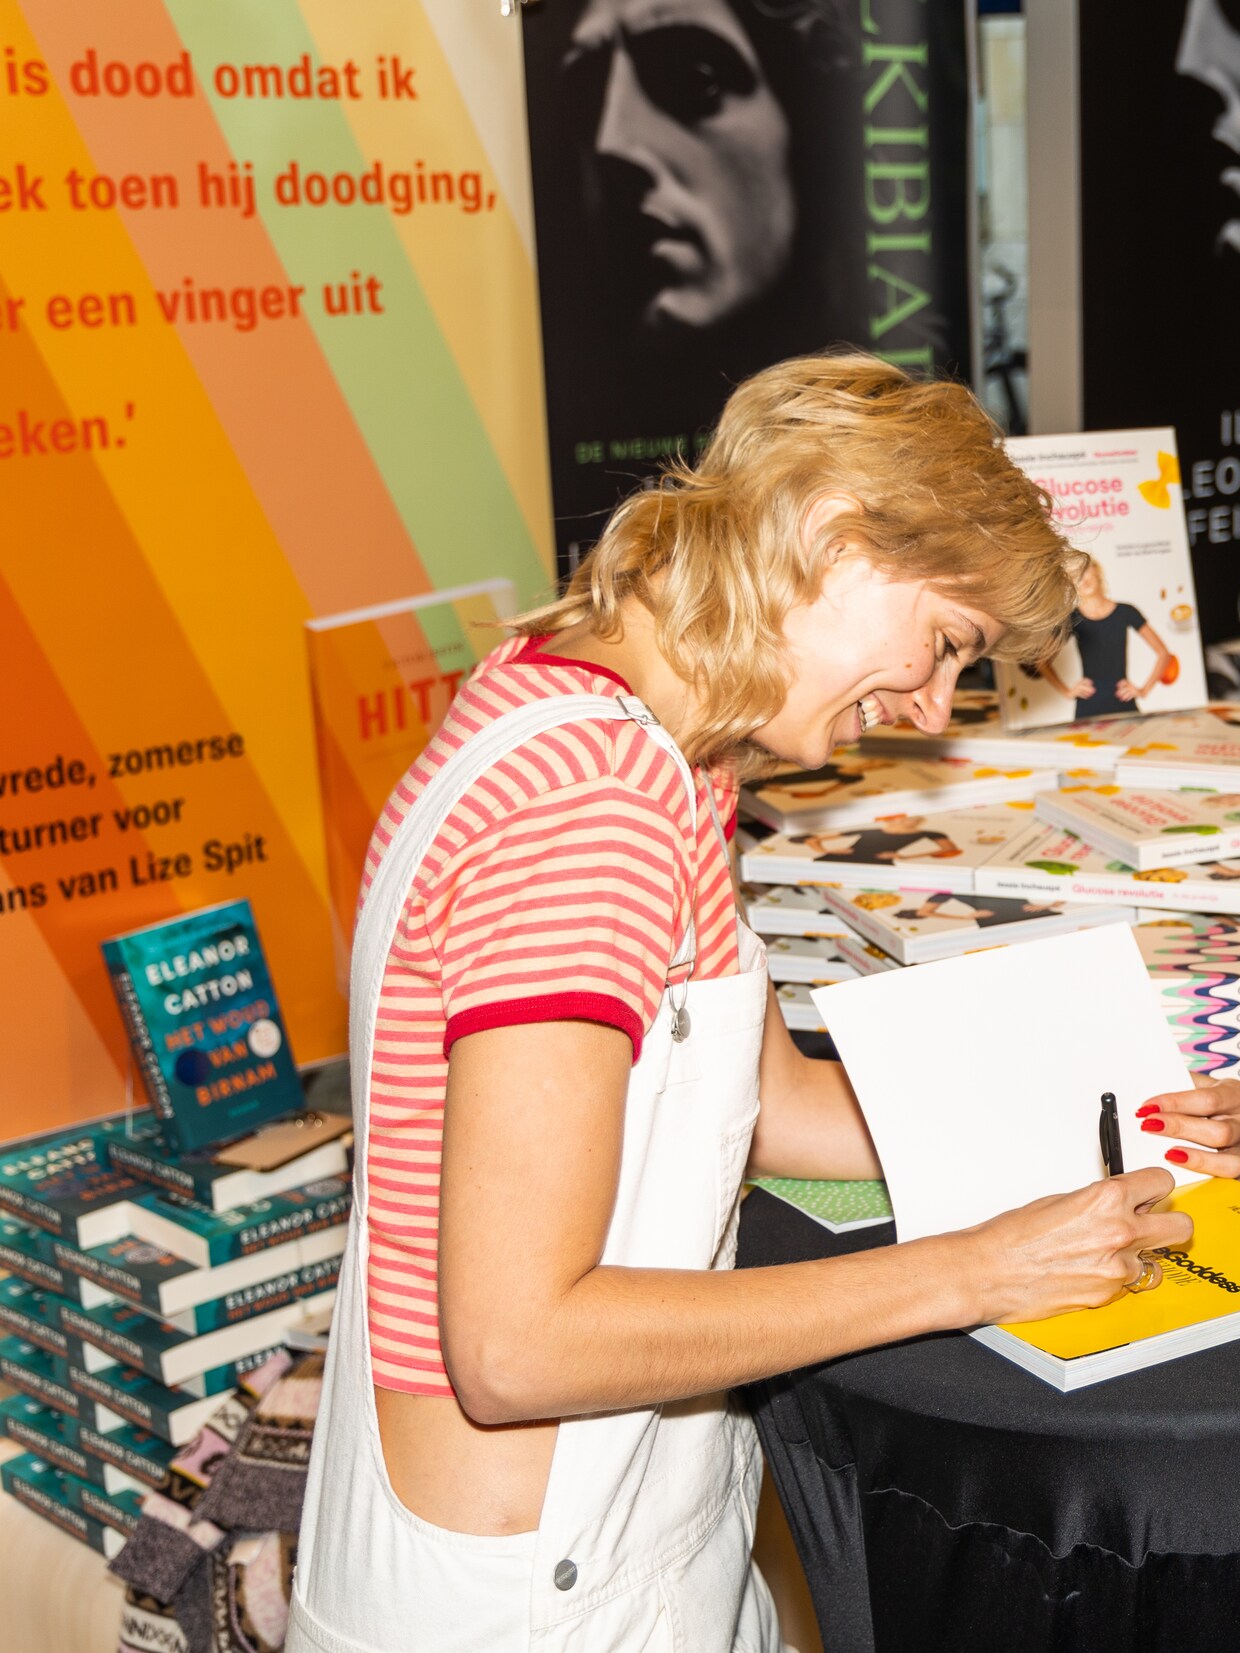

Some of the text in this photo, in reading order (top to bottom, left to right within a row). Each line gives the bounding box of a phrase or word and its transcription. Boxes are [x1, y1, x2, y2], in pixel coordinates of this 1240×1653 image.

[4, 46, 419, 101] is dood omdat ik
[64, 167, 181, 211] toen
[198, 160, 257, 220] hij
[274, 159, 498, 217] doodging,
[46, 291, 138, 330] een
[156, 276, 305, 334] vinger
[322, 270, 386, 318] uit
[1043, 497, 1131, 524] volutie
[108, 732, 246, 779] zomerse
[113, 797, 185, 833] voor
[58, 867, 119, 901] van
[129, 851, 194, 888] Lize
[202, 831, 270, 876] Spit
[1072, 882, 1116, 897] Glucose
[145, 934, 250, 986] ELEANOR
[163, 968, 254, 1016] CATTON
[164, 999, 270, 1054] HET WOUD
[207, 1040, 249, 1068] VAN
[195, 1061, 278, 1107] BIRNAM
[239, 1207, 314, 1245] ELEANOR
[225, 1272, 299, 1310] ELEANOR
